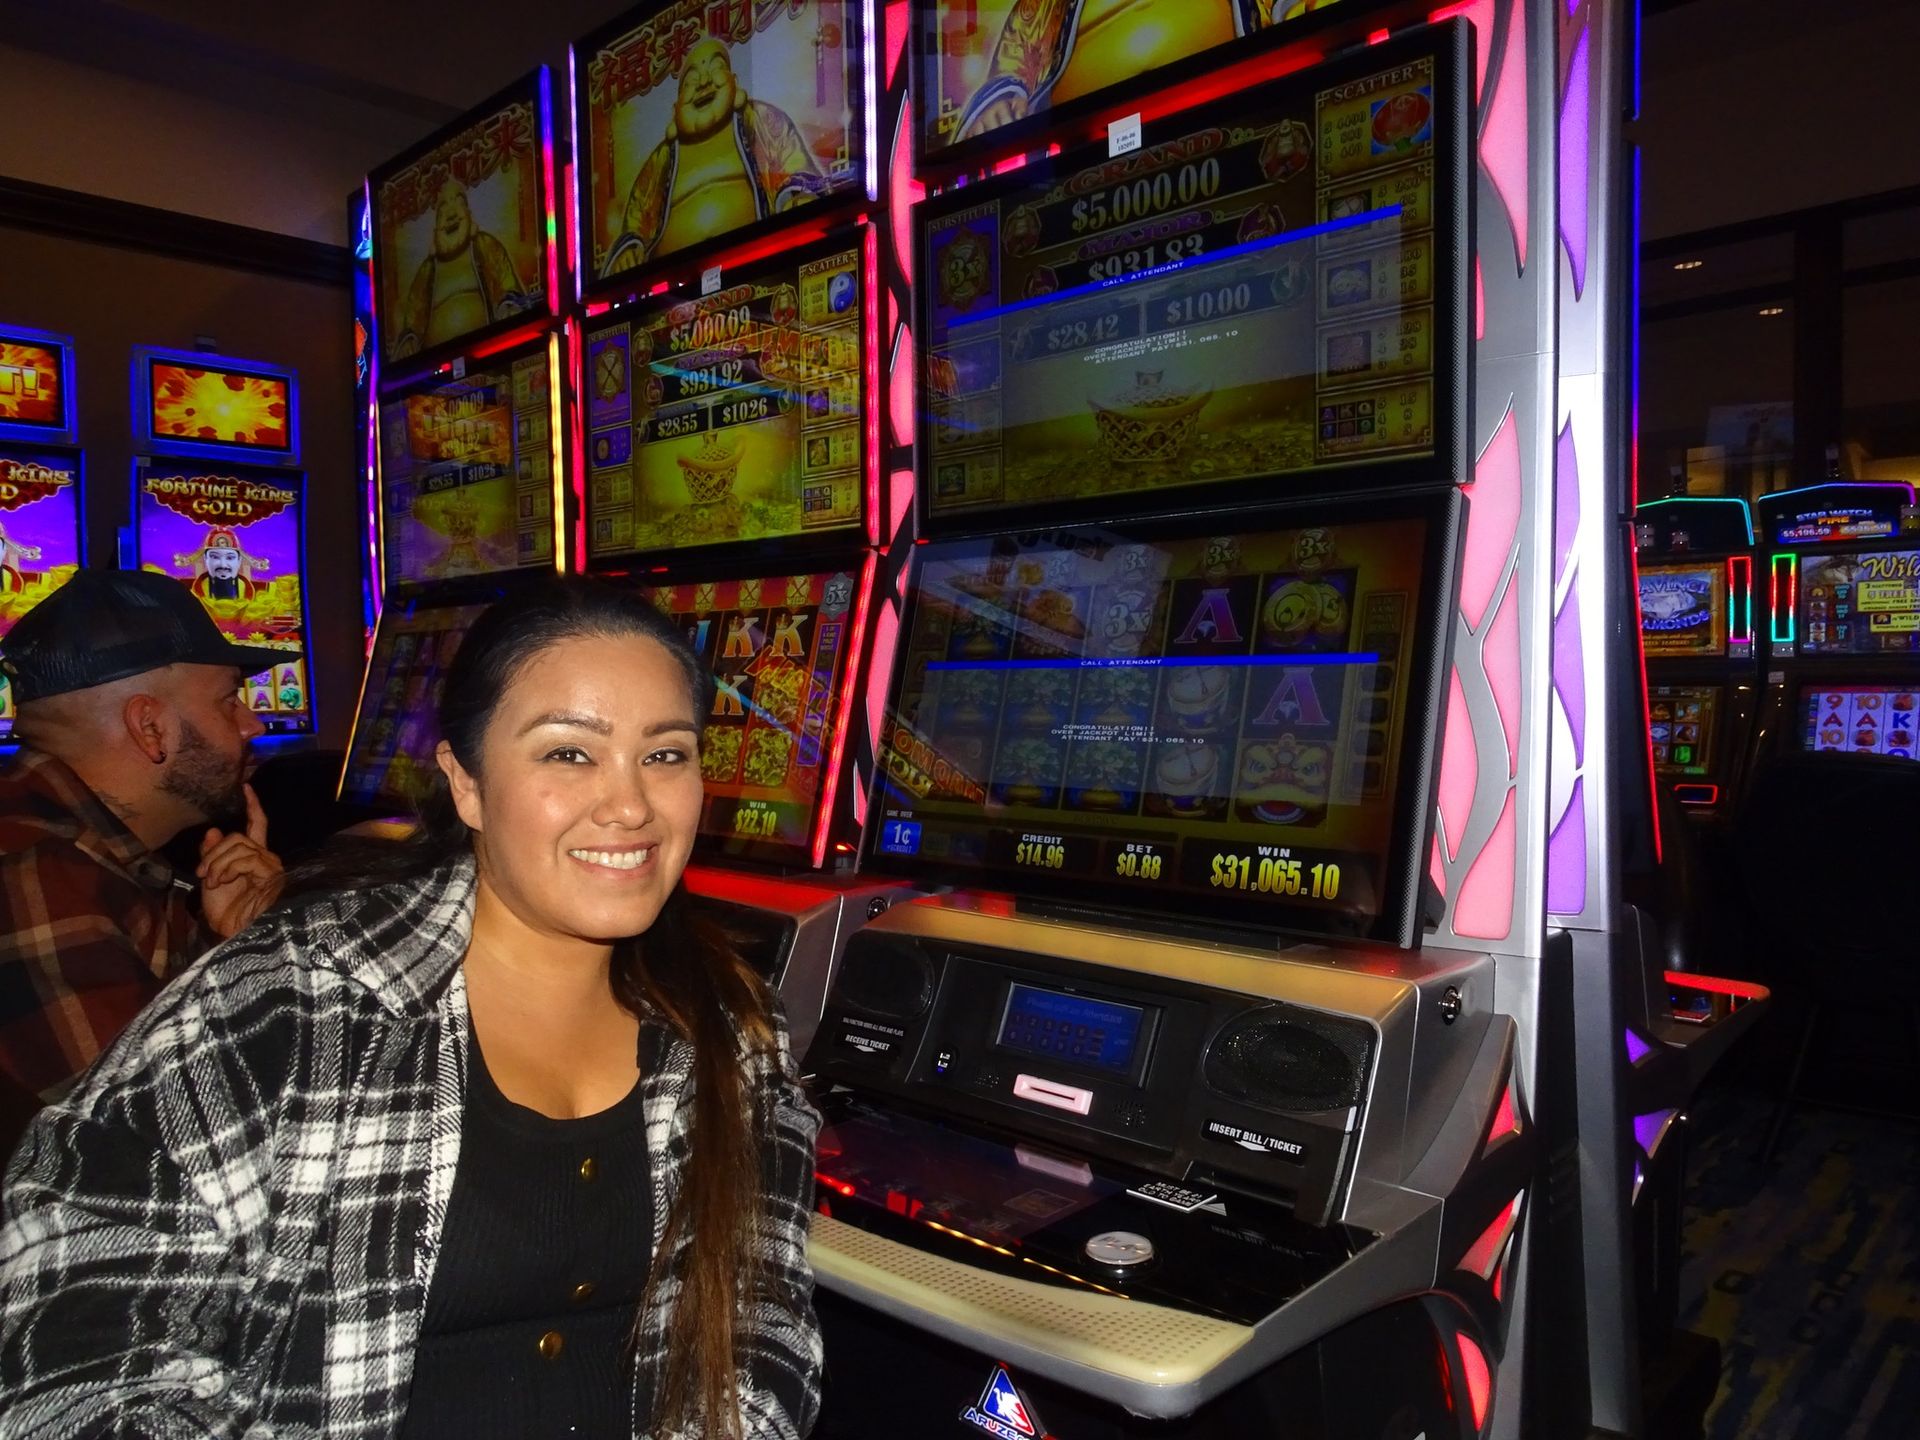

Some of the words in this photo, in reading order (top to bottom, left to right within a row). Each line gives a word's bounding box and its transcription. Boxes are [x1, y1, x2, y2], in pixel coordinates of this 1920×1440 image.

[1333, 67, 1414, 104] SCATTER
[808, 254, 849, 274] SCATTER
[1102, 278, 1125, 287] CALL
[1130, 262, 1185, 280] ATTENDANT
[1084, 351, 1106, 361] OVER
[1112, 343, 1150, 356] JACKPOT
[1157, 335, 1187, 346] LIMIT
[1095, 350, 1145, 364] ATTENDANT
[146, 478, 239, 499] FORTUNE
[192, 499, 252, 517] GOLD
[1174, 588, 1243, 645] A
[722, 617, 760, 658] K
[769, 614, 810, 657] K
[1252, 666, 1330, 726] A
[1826, 695, 1843, 710] 9
[1823, 712, 1843, 727] A
[1856, 712, 1877, 727] A
[1893, 713, 1911, 728] K
[1061, 734, 1112, 742] ATTENDANT
[1022, 833, 1062, 845] CREDIT
[1016, 842, 1065, 869] $14.96
[1126, 843, 1153, 854] BET
[1257, 846, 1291, 858] WIN
[1116, 852, 1162, 880] $0.88
[1210, 853, 1341, 900] $31,065.10
[845, 1034, 870, 1046] RECEIVE
[870, 1040, 890, 1051] TICKET
[1209, 1122, 1242, 1138] INSERT
[1138, 1187, 1156, 1195] OLD
[1156, 1182, 1180, 1190] MUST
